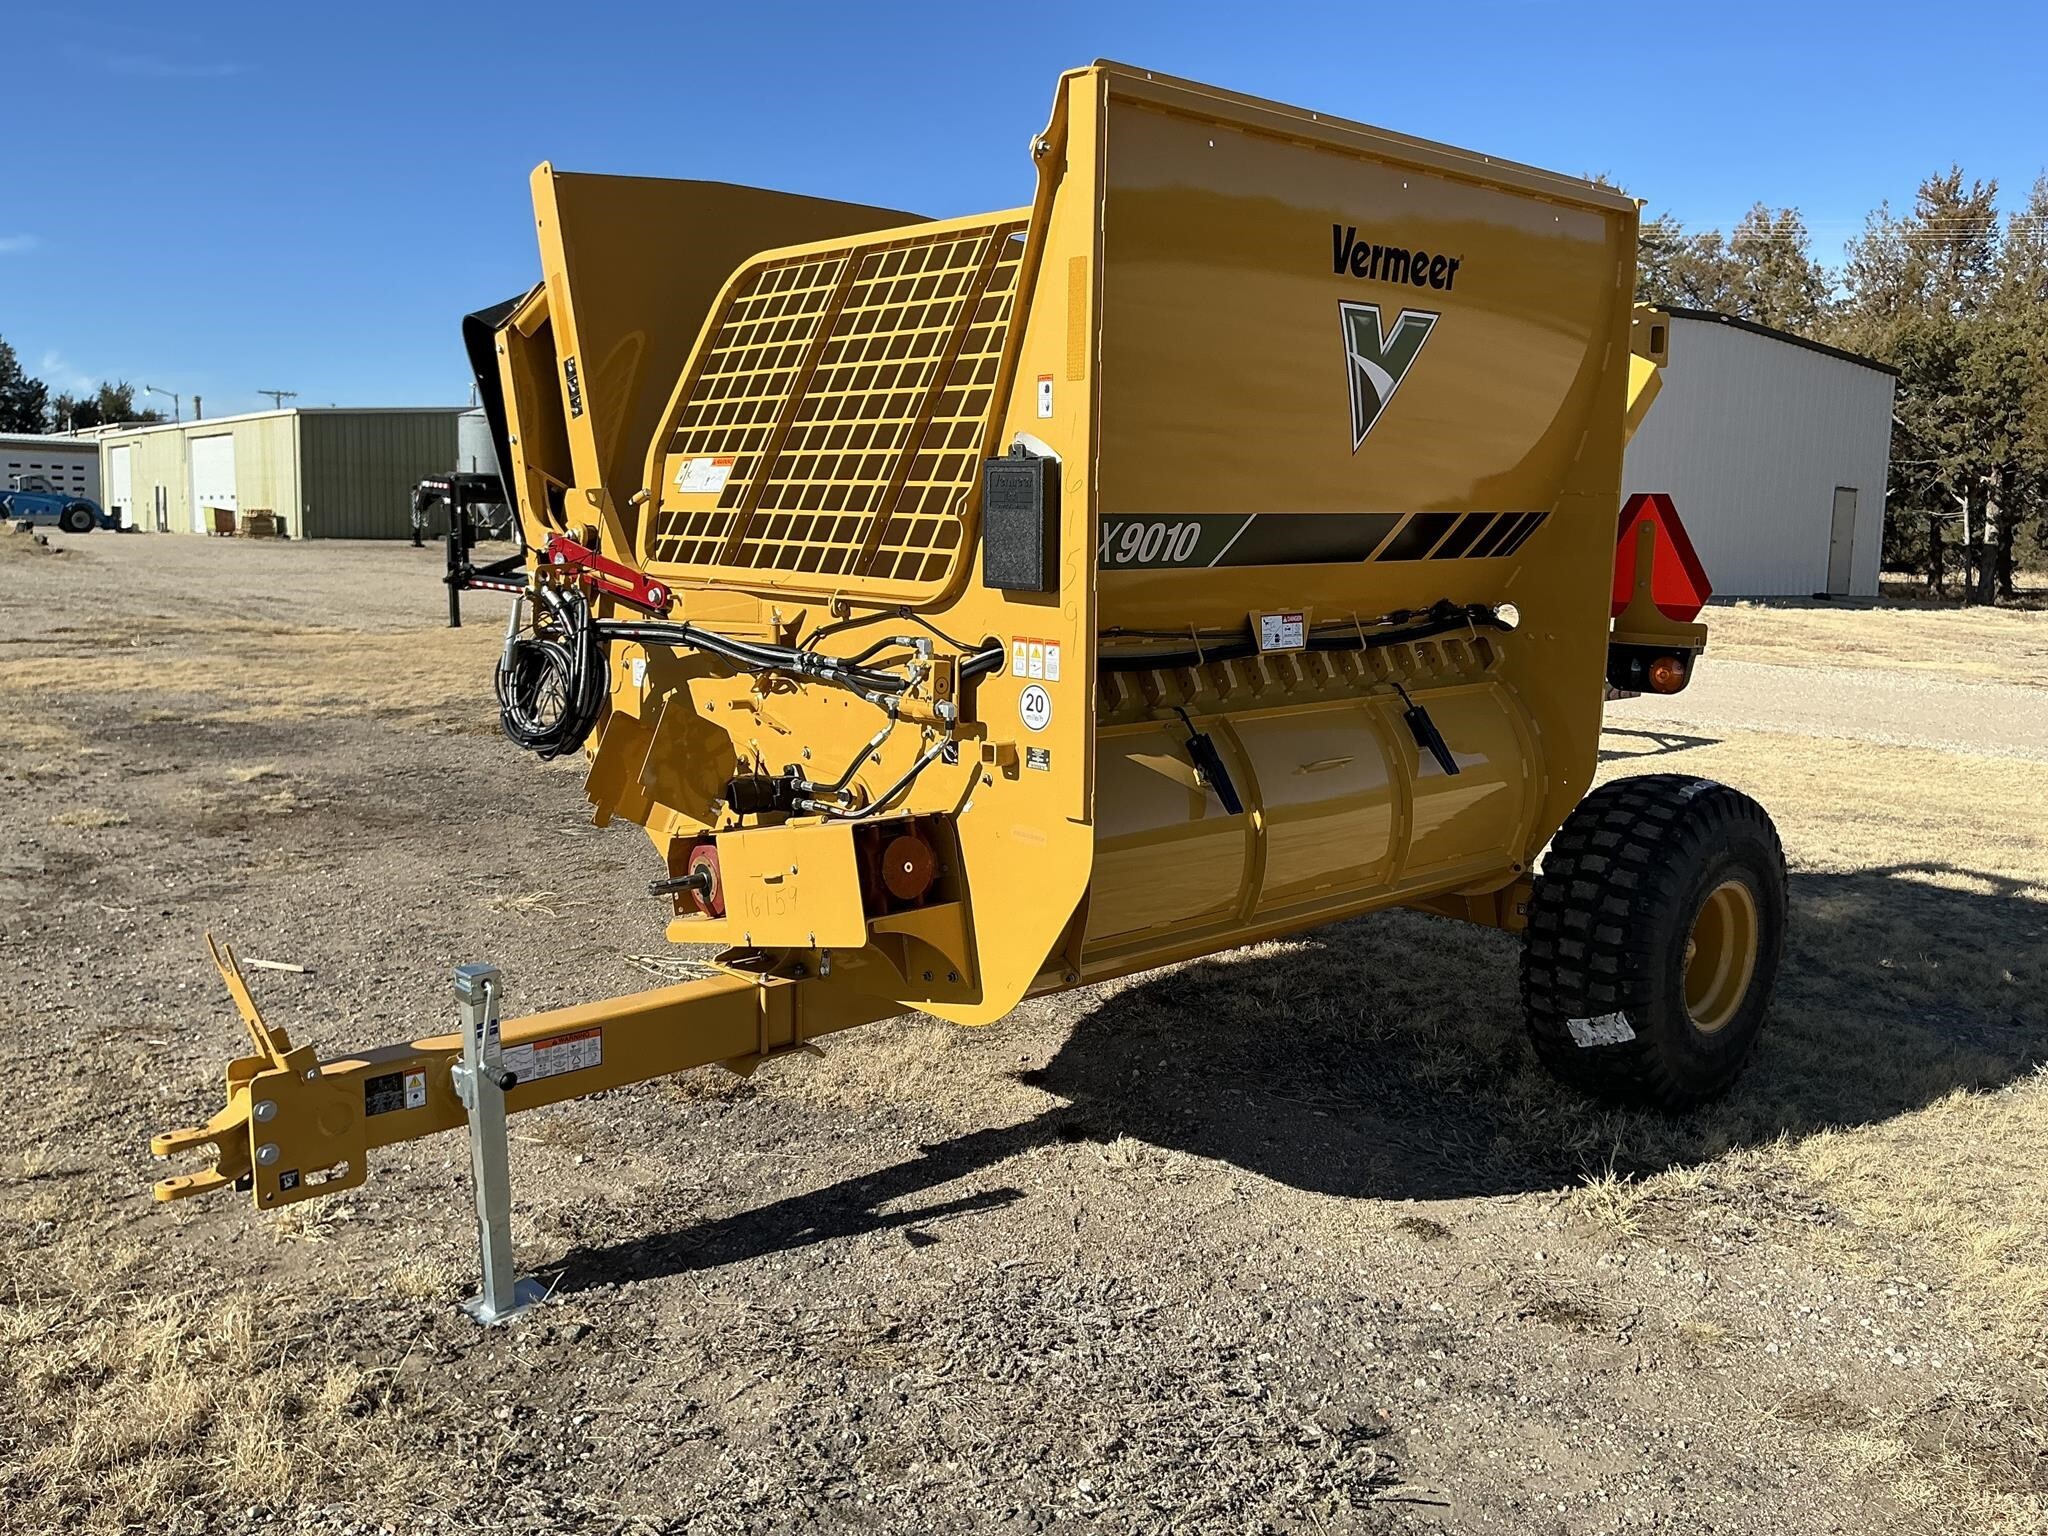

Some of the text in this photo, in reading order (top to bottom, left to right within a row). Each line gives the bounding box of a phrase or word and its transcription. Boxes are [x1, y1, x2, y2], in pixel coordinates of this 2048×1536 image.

[1332, 223, 1460, 291] Vermeer
[1026, 693, 1044, 713] 20
[560, 1031, 590, 1043] WARNING
